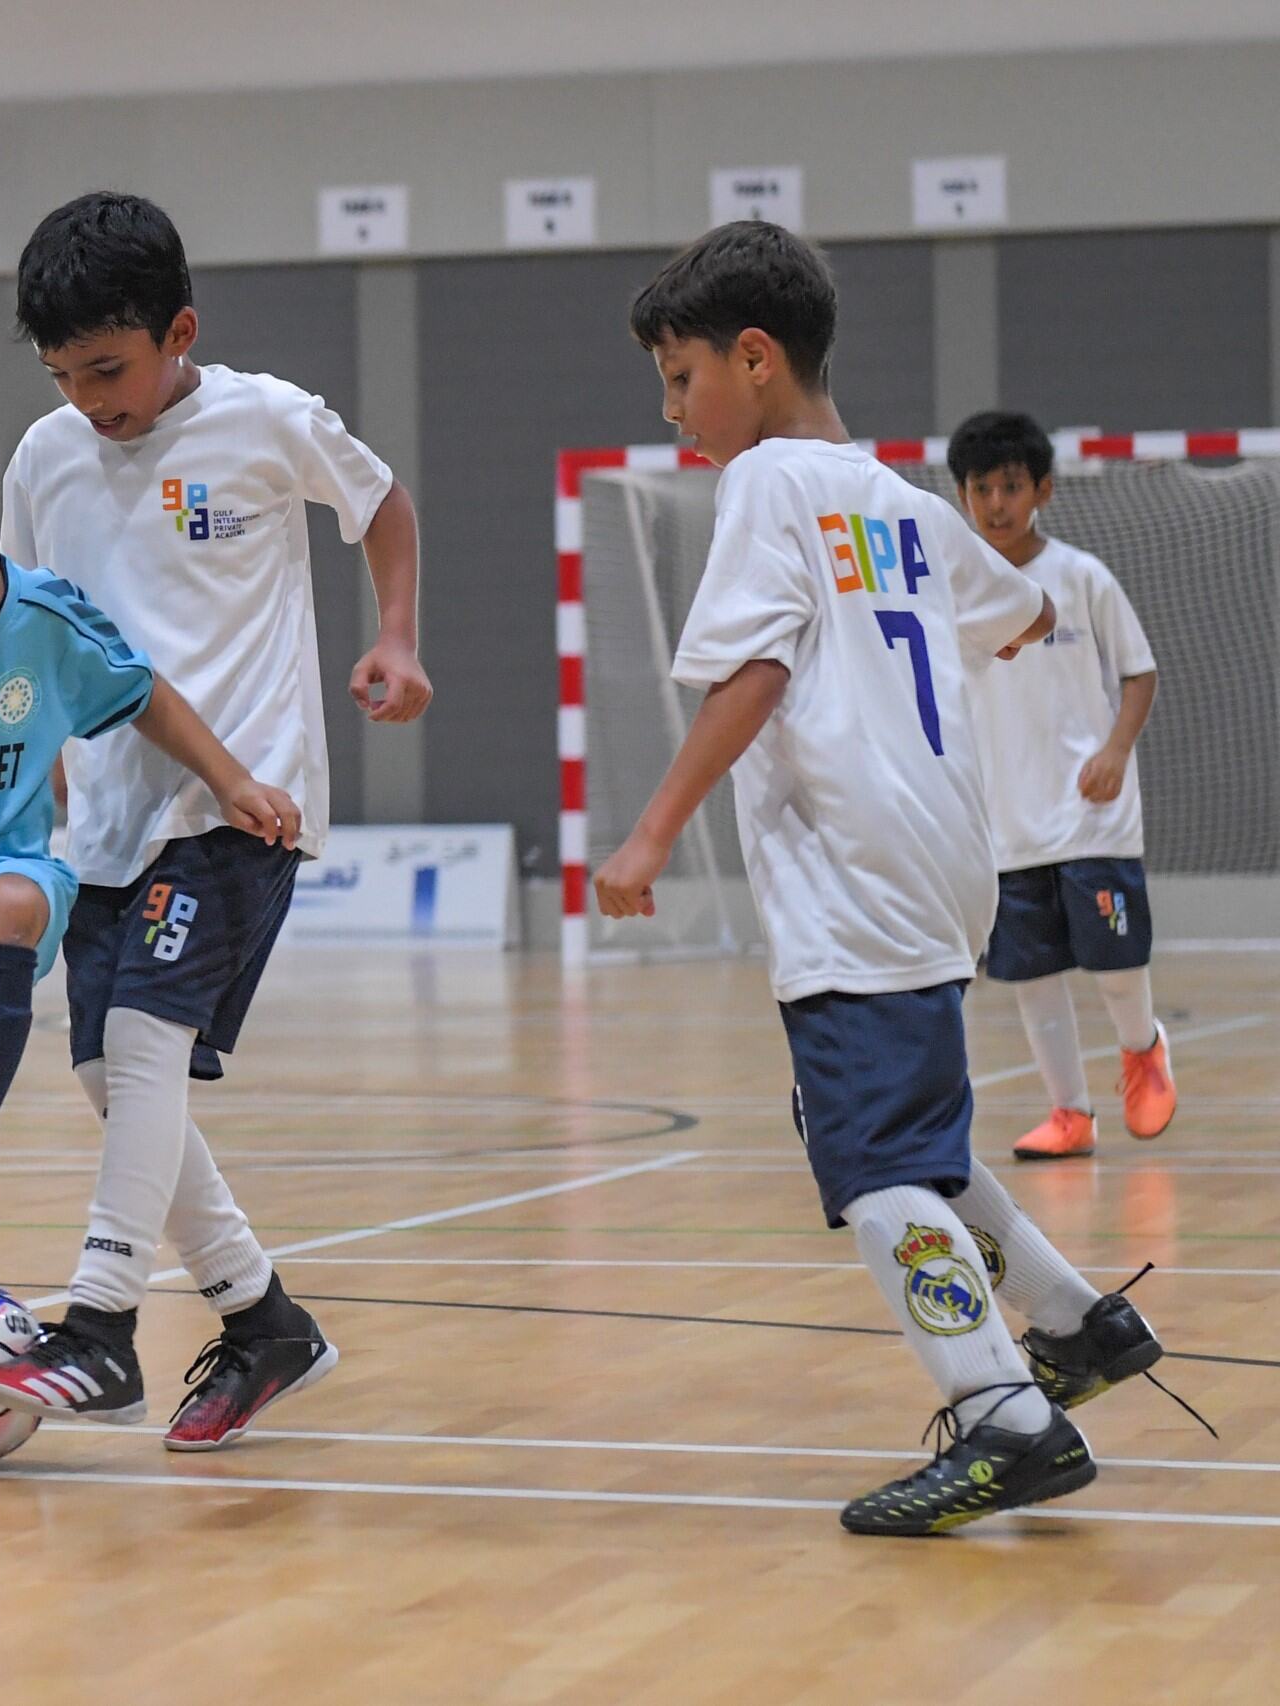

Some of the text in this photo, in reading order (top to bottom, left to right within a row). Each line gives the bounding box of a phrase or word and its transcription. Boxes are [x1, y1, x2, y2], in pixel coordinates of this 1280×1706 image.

[213, 509, 233, 517] GULF
[213, 513, 261, 525] INTERNATI
[214, 529, 246, 540] ACADEMY
[817, 513, 931, 595] GIPA
[873, 610, 945, 757] 7
